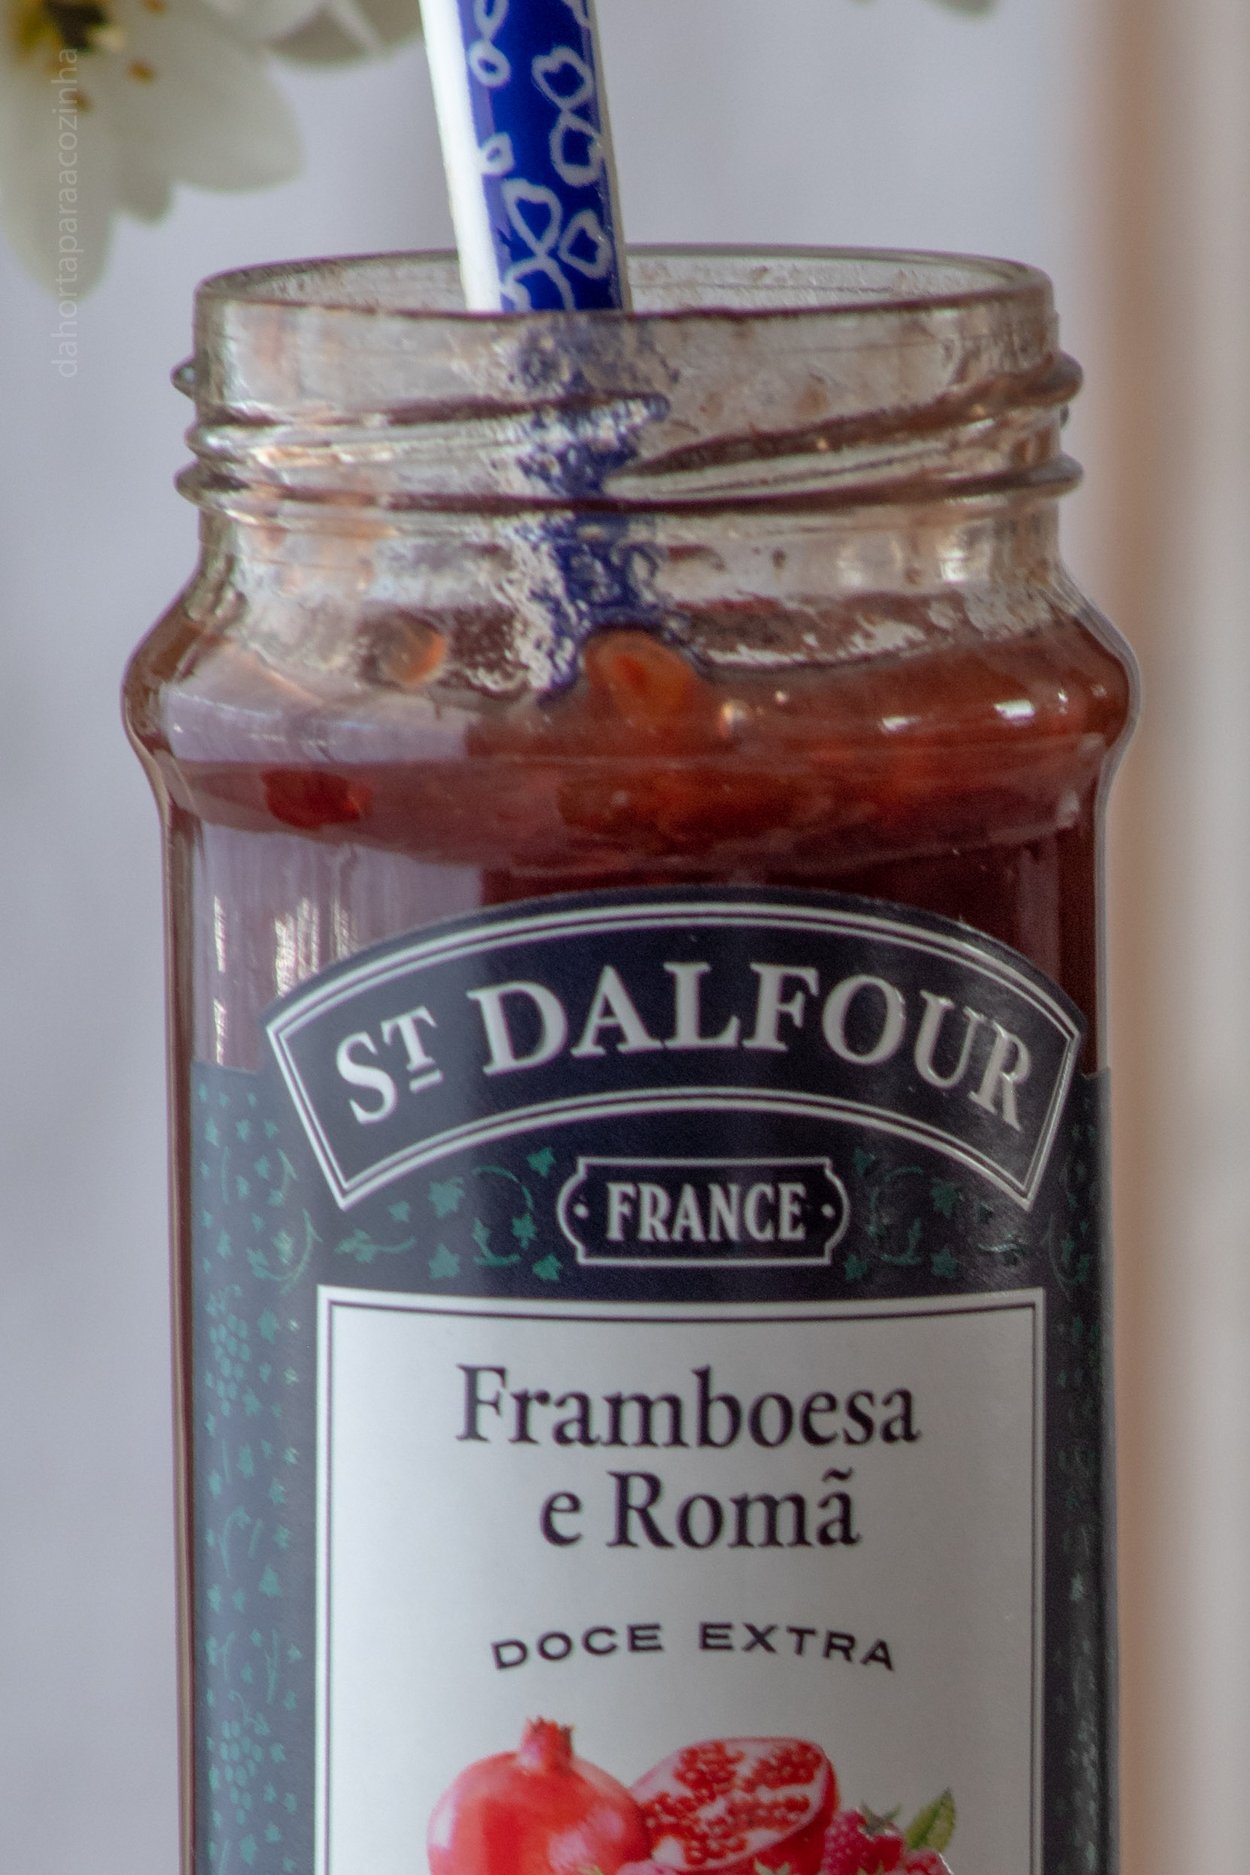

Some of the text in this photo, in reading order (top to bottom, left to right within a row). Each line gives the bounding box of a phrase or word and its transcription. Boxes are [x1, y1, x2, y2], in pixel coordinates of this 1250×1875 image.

[466, 962, 1033, 1132] DALFOUR
[605, 1182, 807, 1243] FRANCE
[456, 1364, 922, 1449] Framboesa
[540, 1467, 862, 1549] e Romã
[491, 1622, 896, 1672] DOCE EXTRA
